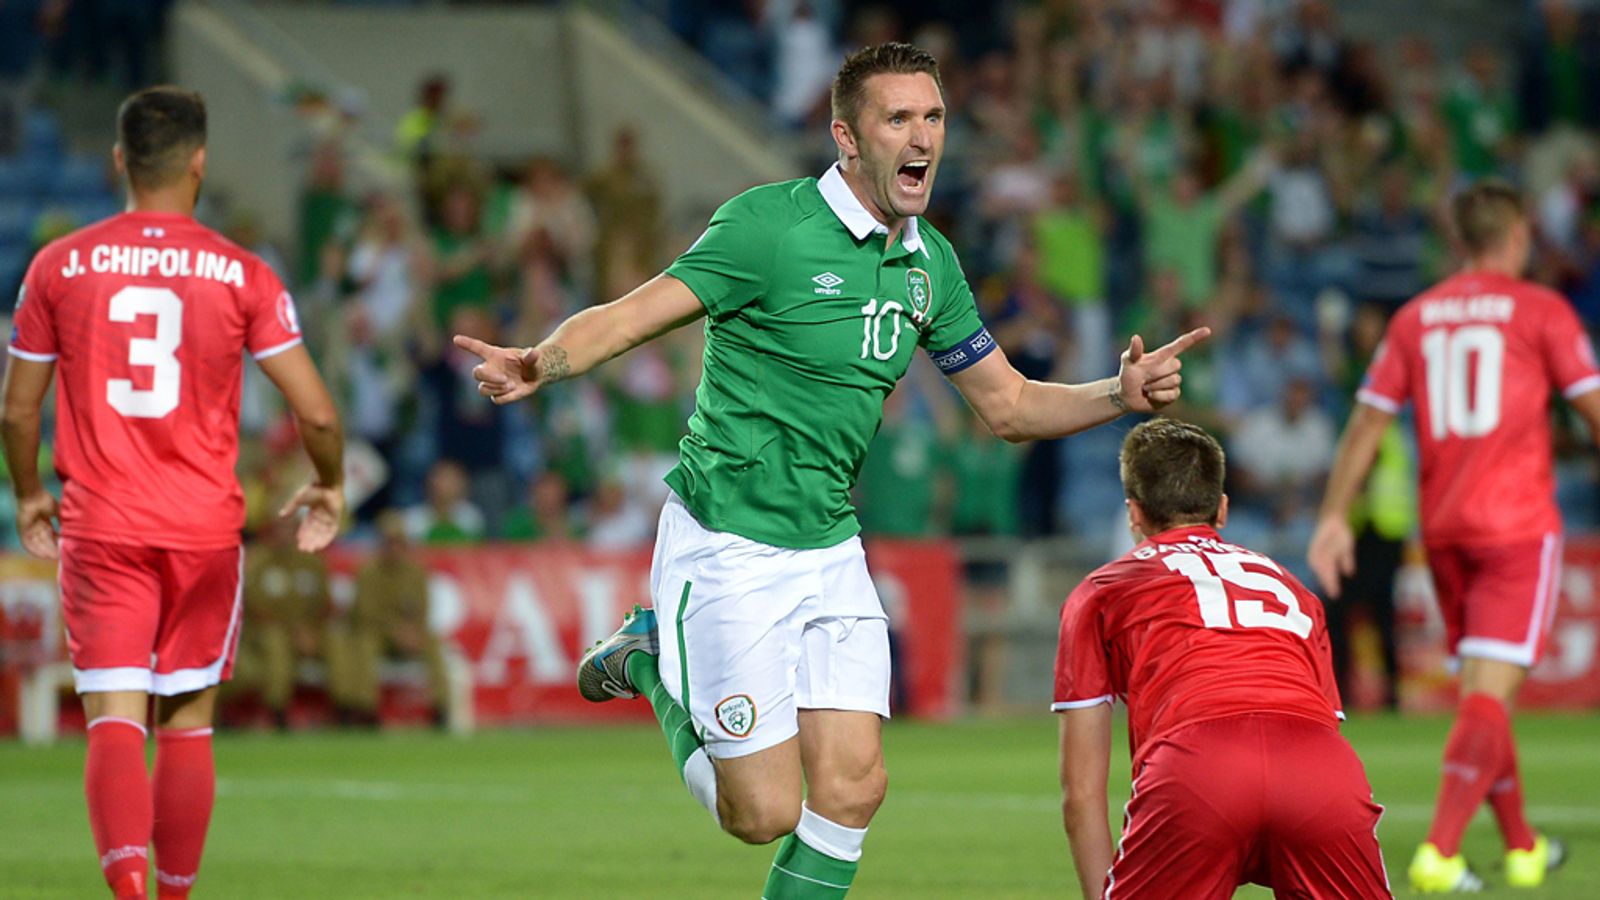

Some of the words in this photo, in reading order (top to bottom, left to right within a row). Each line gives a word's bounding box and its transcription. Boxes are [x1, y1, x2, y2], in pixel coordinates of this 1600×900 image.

[61, 249, 86, 278] J.
[90, 245, 244, 288] CHIPOLINA
[814, 287, 841, 295] umbro
[106, 286, 183, 419] 3
[861, 298, 904, 361] 10
[1421, 322, 1504, 442] 10
[1161, 550, 1313, 640] 15
